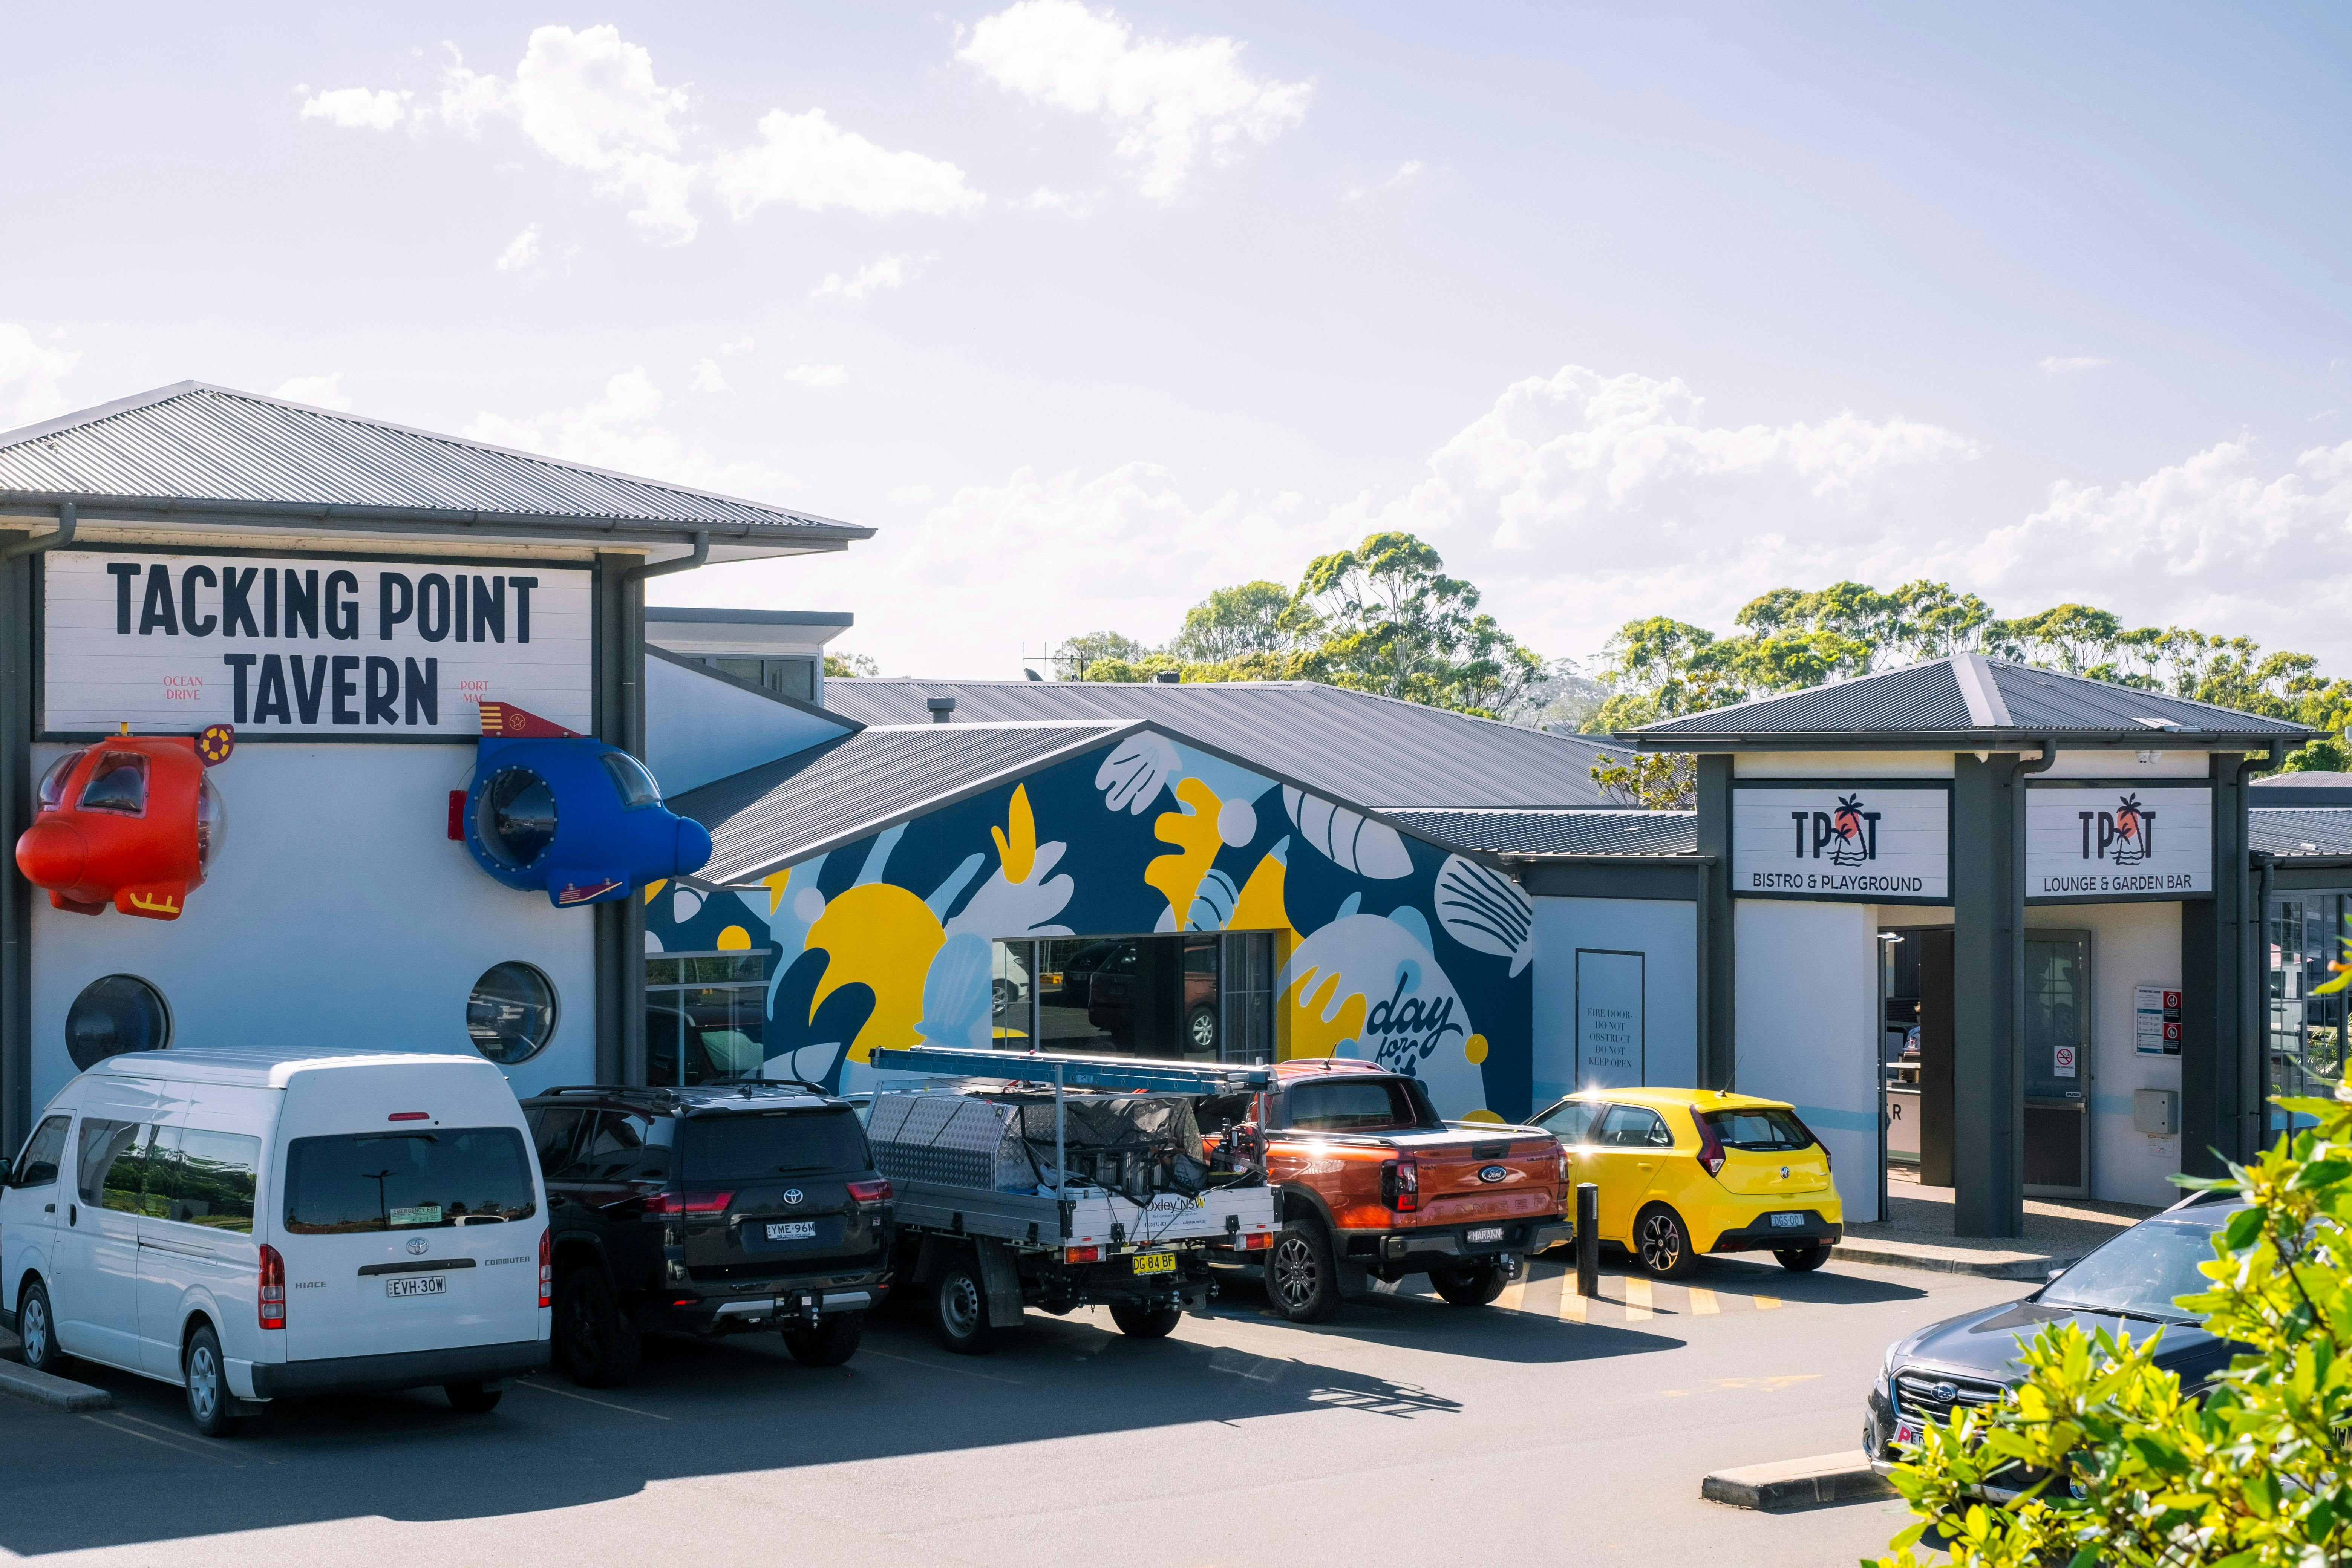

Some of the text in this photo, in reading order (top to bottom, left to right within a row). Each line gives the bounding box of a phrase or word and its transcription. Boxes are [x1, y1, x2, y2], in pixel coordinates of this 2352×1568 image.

[107, 562, 539, 644] TACKING POINT
[163, 676, 202, 686] OCEAN
[461, 681, 489, 691] PORT
[167, 689, 200, 699] DRIVE
[224, 653, 438, 726] TAVERN
[1753, 873, 1922, 891] BISTRO & PLAYGROUND
[2044, 874, 2192, 892] LOUNGE & GARDEN BAR
[1367, 971, 1464, 1059] day
[1588, 1008, 1605, 1017] FIRE
[1595, 1021, 1625, 1031] DO NOT
[1589, 1033, 1631, 1043] OBSTRUCT
[1595, 1045, 1625, 1055] DO NOT
[1589, 1057, 1632, 1068] KEEP OPEN
[1147, 1199, 1177, 1213] Oxley
[1472, 1228, 1501, 1240] MARANN
[485, 1256, 530, 1266] COMMUTER
[1897, 1426, 1911, 1442] P
